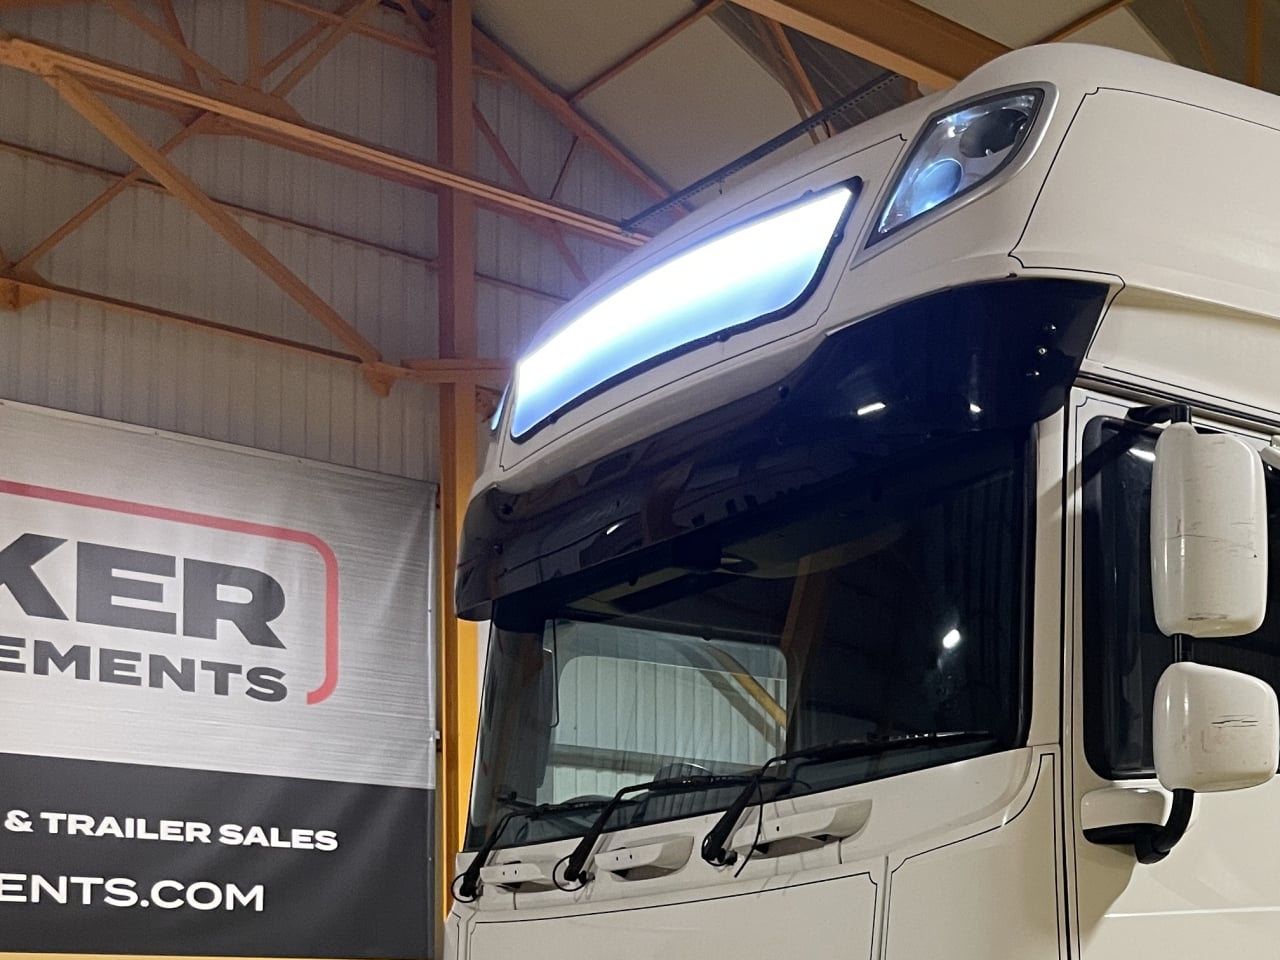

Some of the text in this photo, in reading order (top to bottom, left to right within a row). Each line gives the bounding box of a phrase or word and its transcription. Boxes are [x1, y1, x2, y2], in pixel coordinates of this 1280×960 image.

[4, 810, 339, 851] & TRAILER SALES
[0, 872, 265, 912] ENTS.COM
